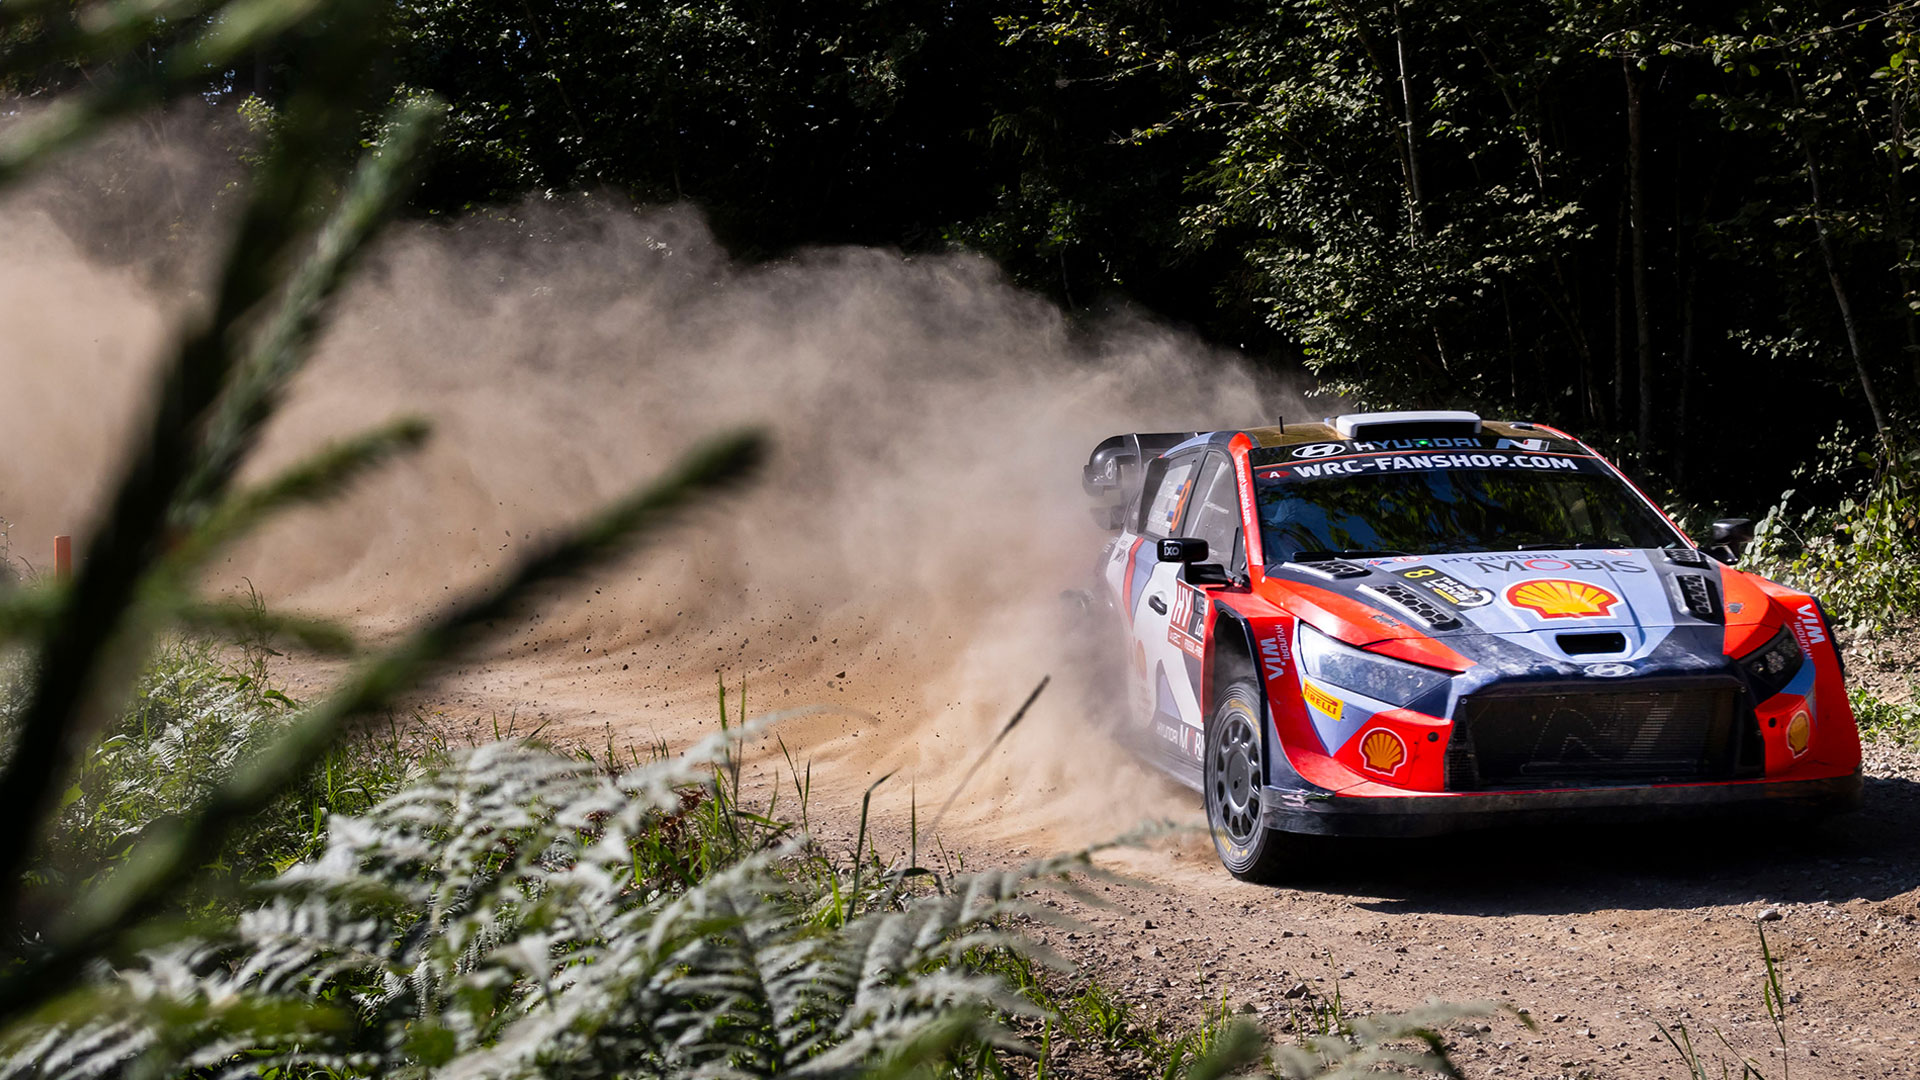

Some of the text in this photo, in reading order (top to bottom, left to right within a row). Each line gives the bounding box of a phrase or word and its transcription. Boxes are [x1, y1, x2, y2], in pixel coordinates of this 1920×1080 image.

[1353, 438, 1482, 451] HYUNDAI
[1269, 470, 1280, 478] A
[1293, 455, 1579, 477] WRC-FANSHOP.COM
[1441, 554, 1559, 563] HYUNDAI
[1474, 559, 1648, 573] MOBIS
[1403, 569, 1436, 578] 8
[1172, 584, 1193, 628] HY
[1797, 603, 1826, 644] WIA
[1274, 624, 1291, 660] HYUNDAI
[1260, 637, 1286, 681] WIA
[1304, 683, 1338, 715] PIRELLI
